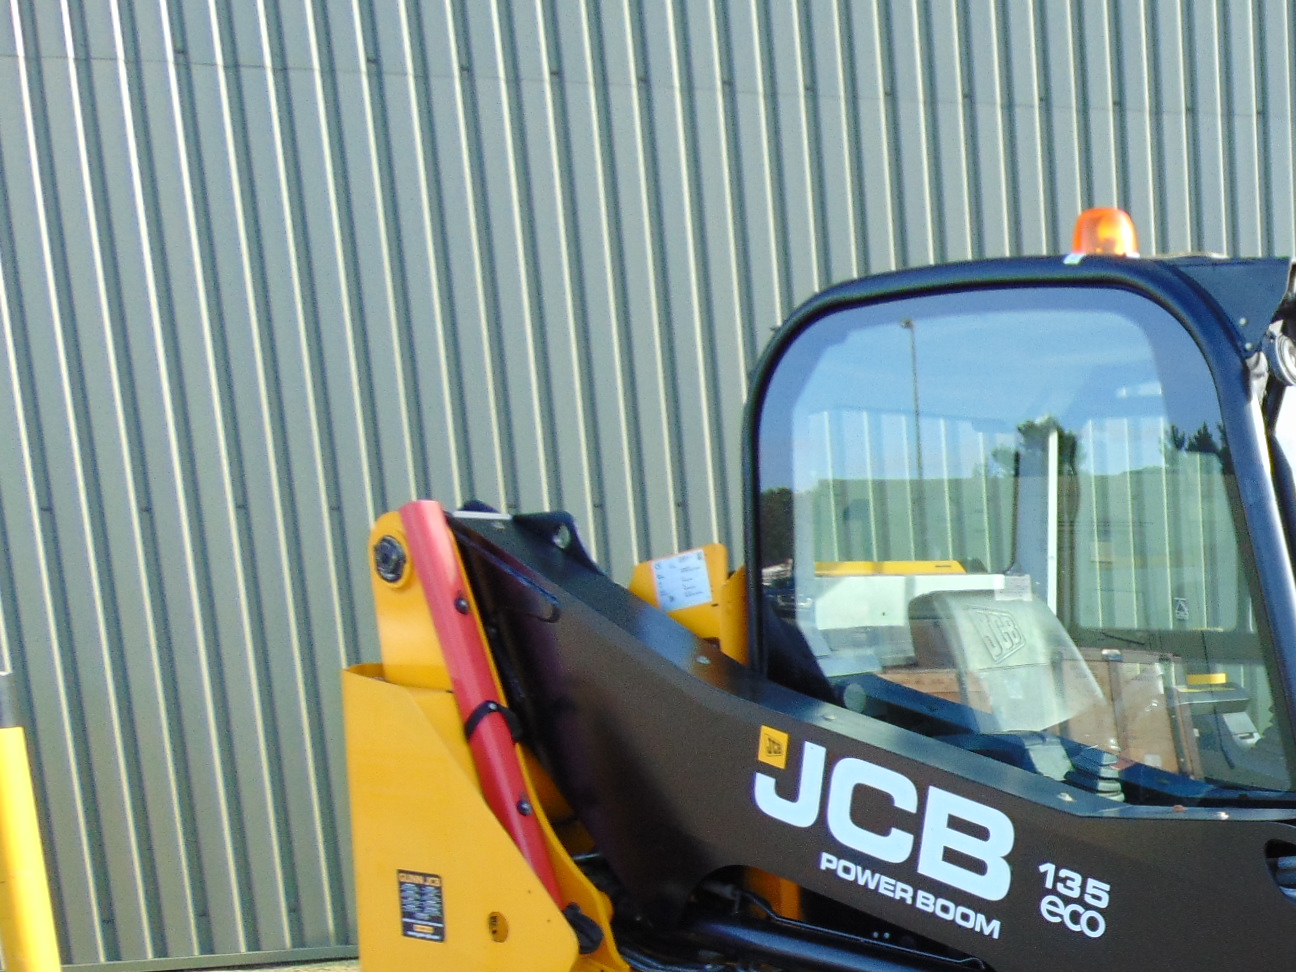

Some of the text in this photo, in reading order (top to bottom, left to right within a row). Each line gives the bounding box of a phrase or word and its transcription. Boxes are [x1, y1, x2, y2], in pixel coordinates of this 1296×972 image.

[975, 611, 1023, 658] JCB
[754, 740, 1016, 902] JCB
[1038, 862, 1111, 909] 135
[1040, 894, 1107, 938] eco
